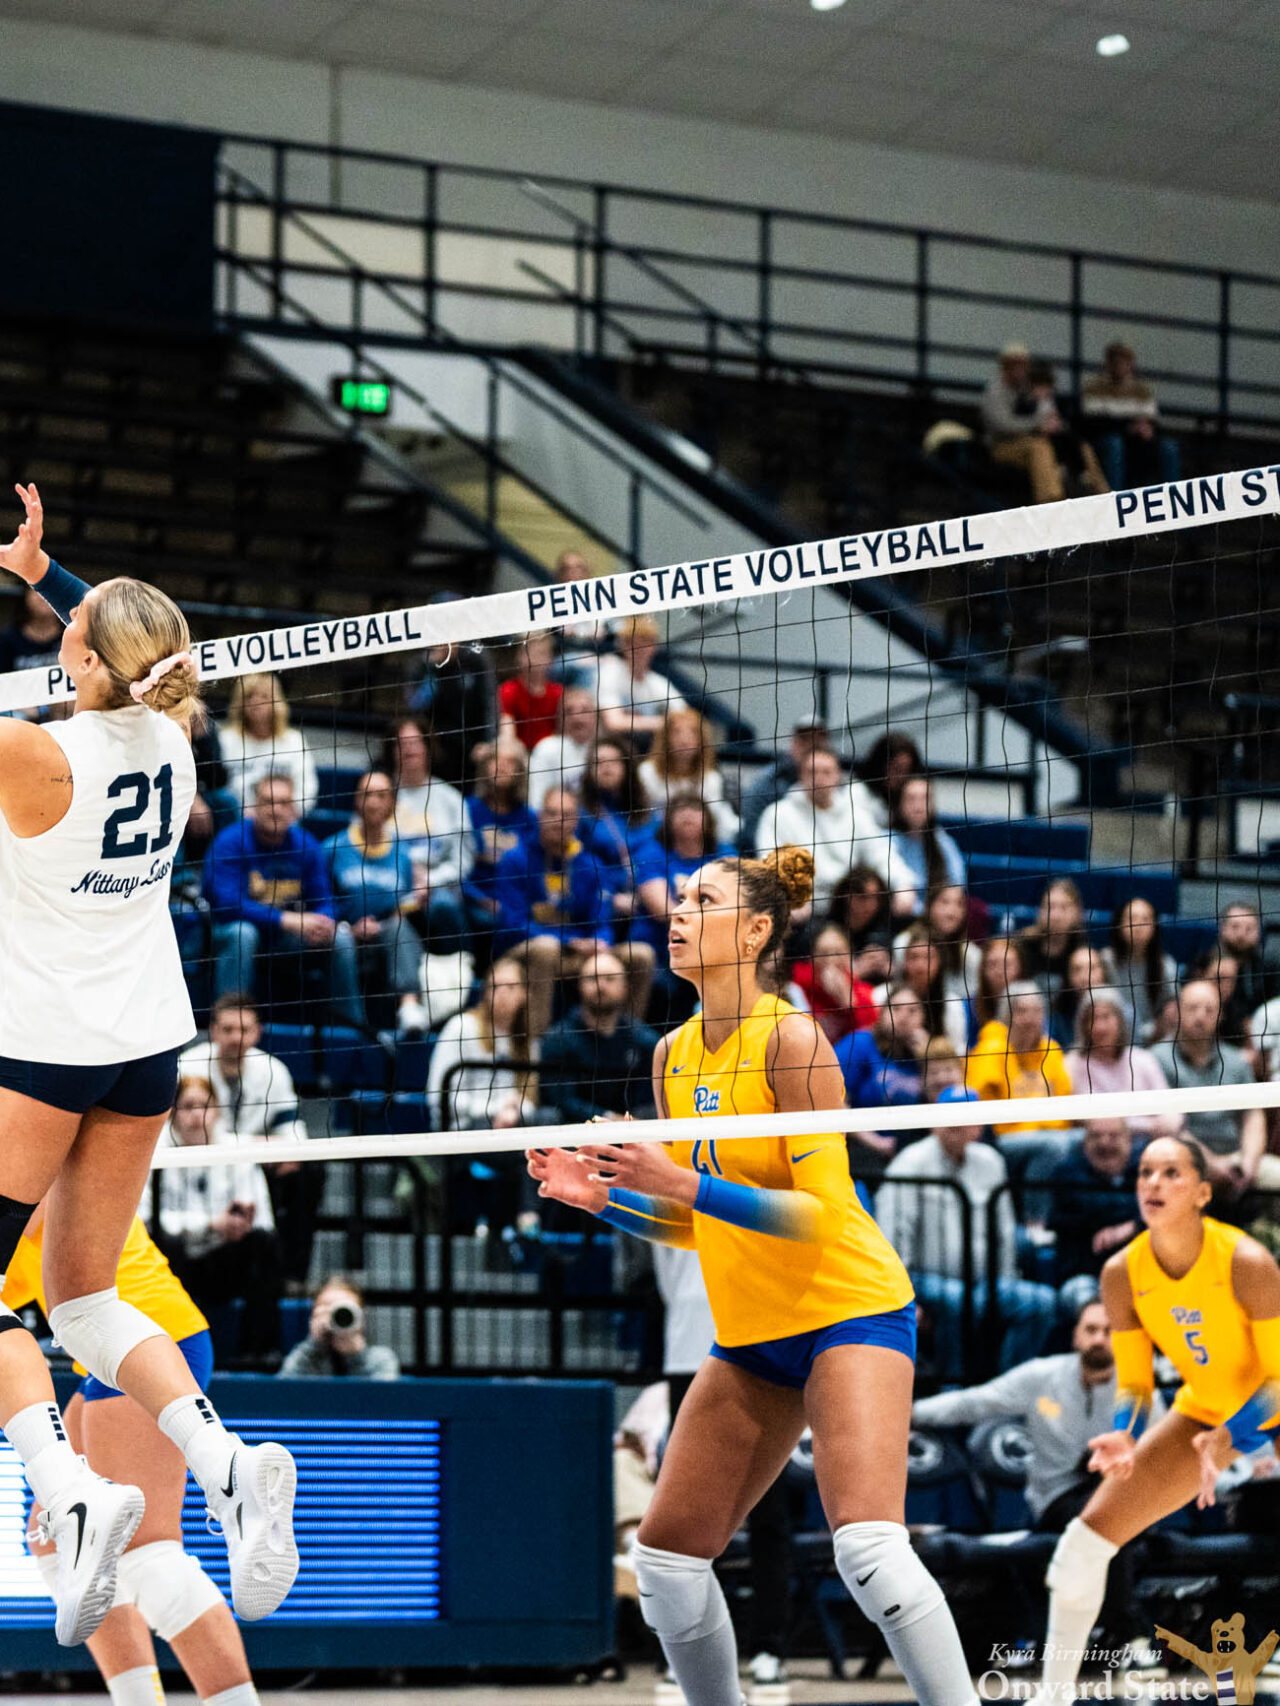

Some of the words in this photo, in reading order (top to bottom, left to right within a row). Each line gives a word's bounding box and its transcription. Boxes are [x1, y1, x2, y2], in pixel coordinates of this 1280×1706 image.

[1115, 476, 1226, 528] PENN
[527, 578, 616, 622] PENN
[629, 558, 734, 605] STATE
[745, 518, 985, 587] VOLLEYBALL
[226, 611, 422, 667] VOLLEYBALL
[100, 762, 173, 859] 21
[71, 869, 139, 899] Nittany
[694, 1086, 720, 1113] Pitt
[1184, 1331, 1209, 1366] 5
